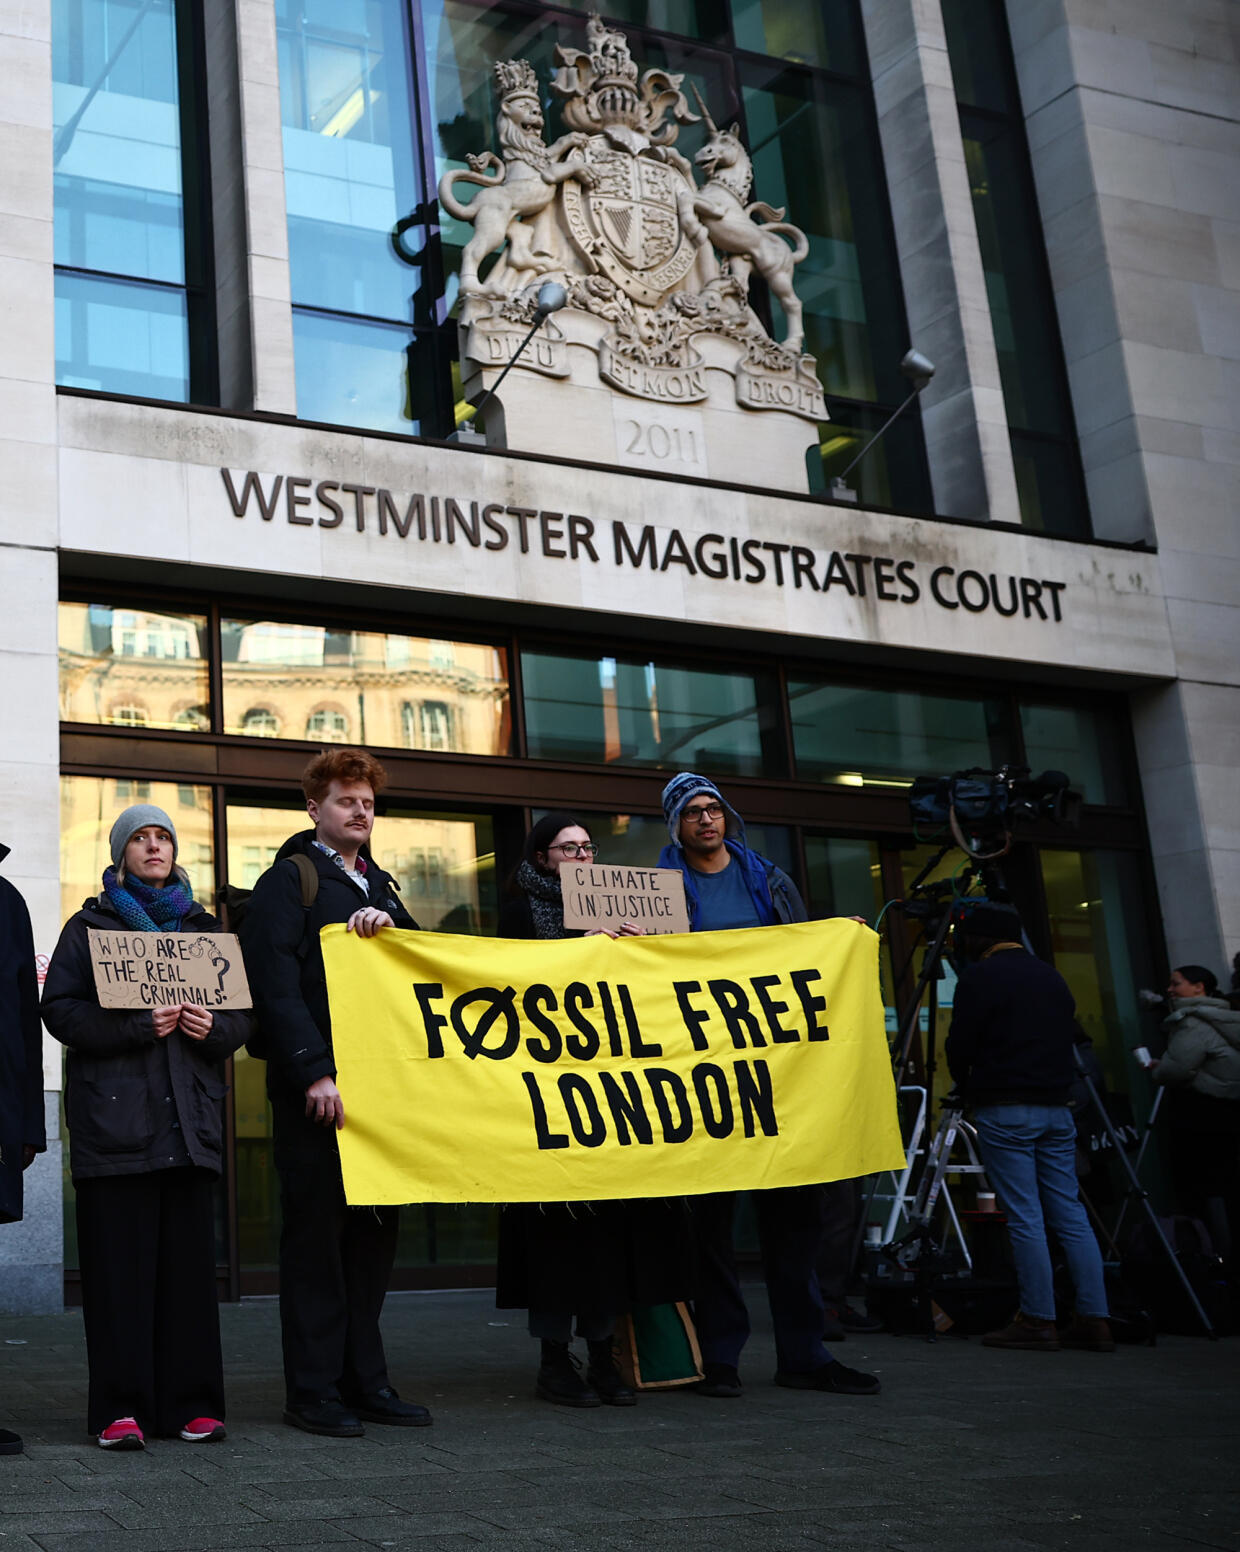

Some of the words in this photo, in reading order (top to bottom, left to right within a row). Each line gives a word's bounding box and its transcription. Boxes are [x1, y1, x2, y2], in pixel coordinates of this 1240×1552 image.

[487, 336, 554, 368] DIEU
[610, 357, 637, 390] ET
[648, 369, 707, 399] MON
[749, 377, 820, 414] DROIT
[625, 419, 700, 464] 2011
[221, 467, 600, 563] WESTMINSTER
[613, 521, 920, 604] MAGISTRATES
[929, 566, 1066, 622] COURT
[575, 868, 660, 890] CLIMATE
[98, 937, 146, 958] WHO
[156, 938, 190, 960] ARE
[98, 960, 138, 983] THE
[146, 961, 186, 983] REAL
[674, 969, 829, 1052] FREE
[522, 1059, 779, 1150] LONDON
